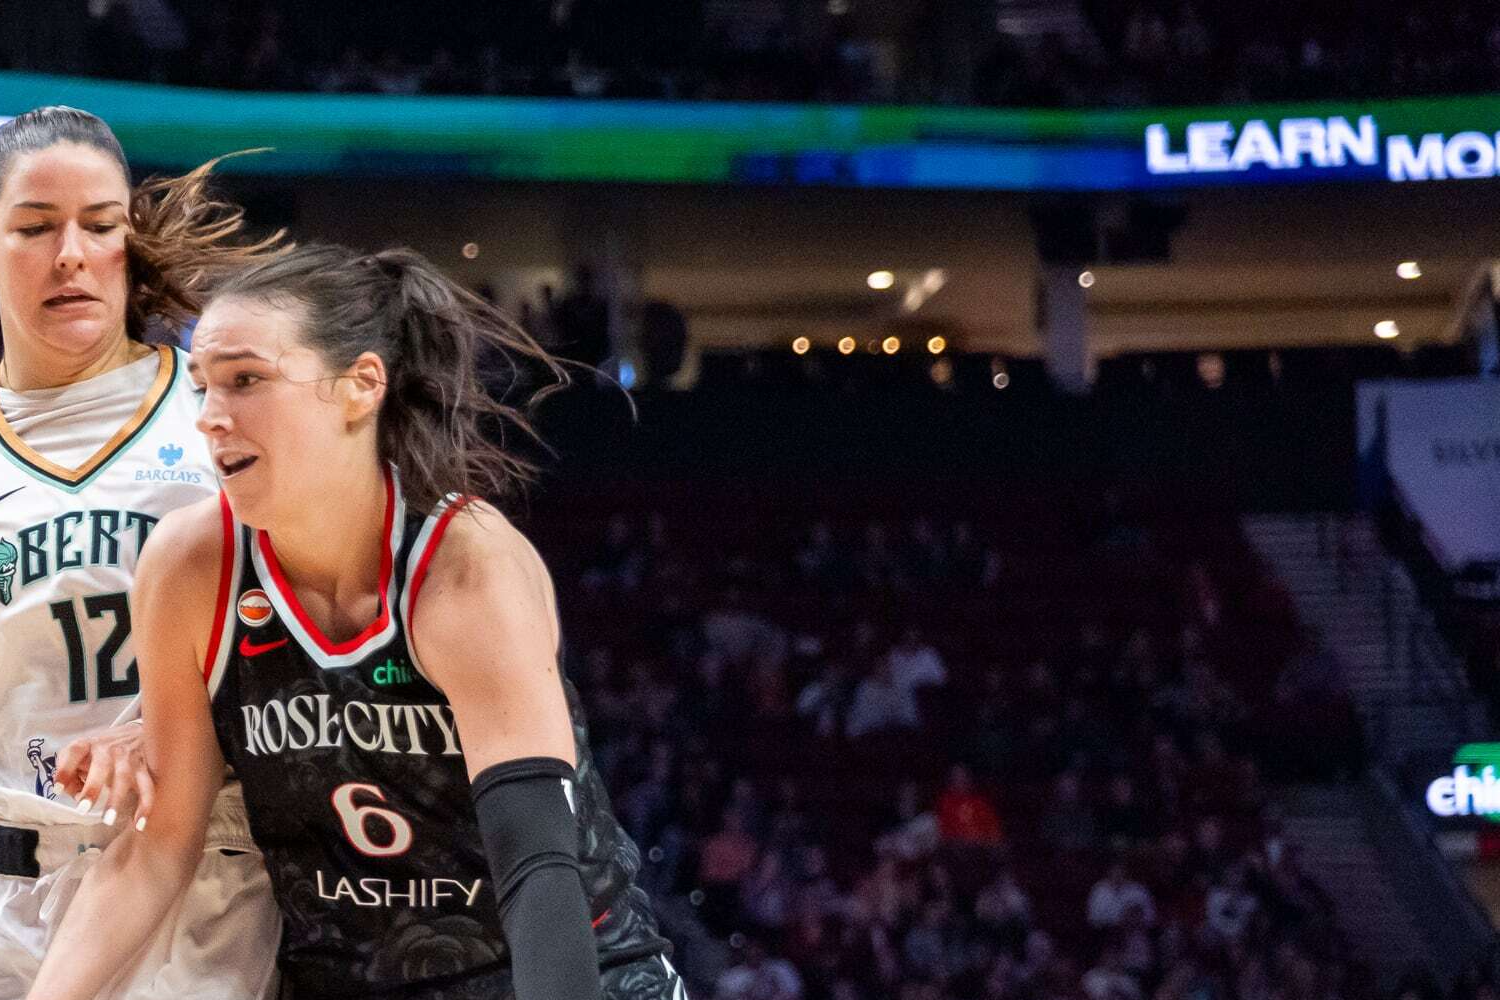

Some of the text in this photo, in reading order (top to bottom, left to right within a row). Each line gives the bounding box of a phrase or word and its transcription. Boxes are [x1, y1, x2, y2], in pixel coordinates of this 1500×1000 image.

[1145, 115, 1500, 182] LEARN MO
[134, 469, 202, 484] BARCLAYS
[49, 591, 140, 704] 12
[373, 659, 412, 686] chi
[343, 699, 462, 756] CITY
[1425, 764, 1500, 818] chi
[330, 781, 413, 858] 6
[316, 869, 483, 908] LASHIFY
